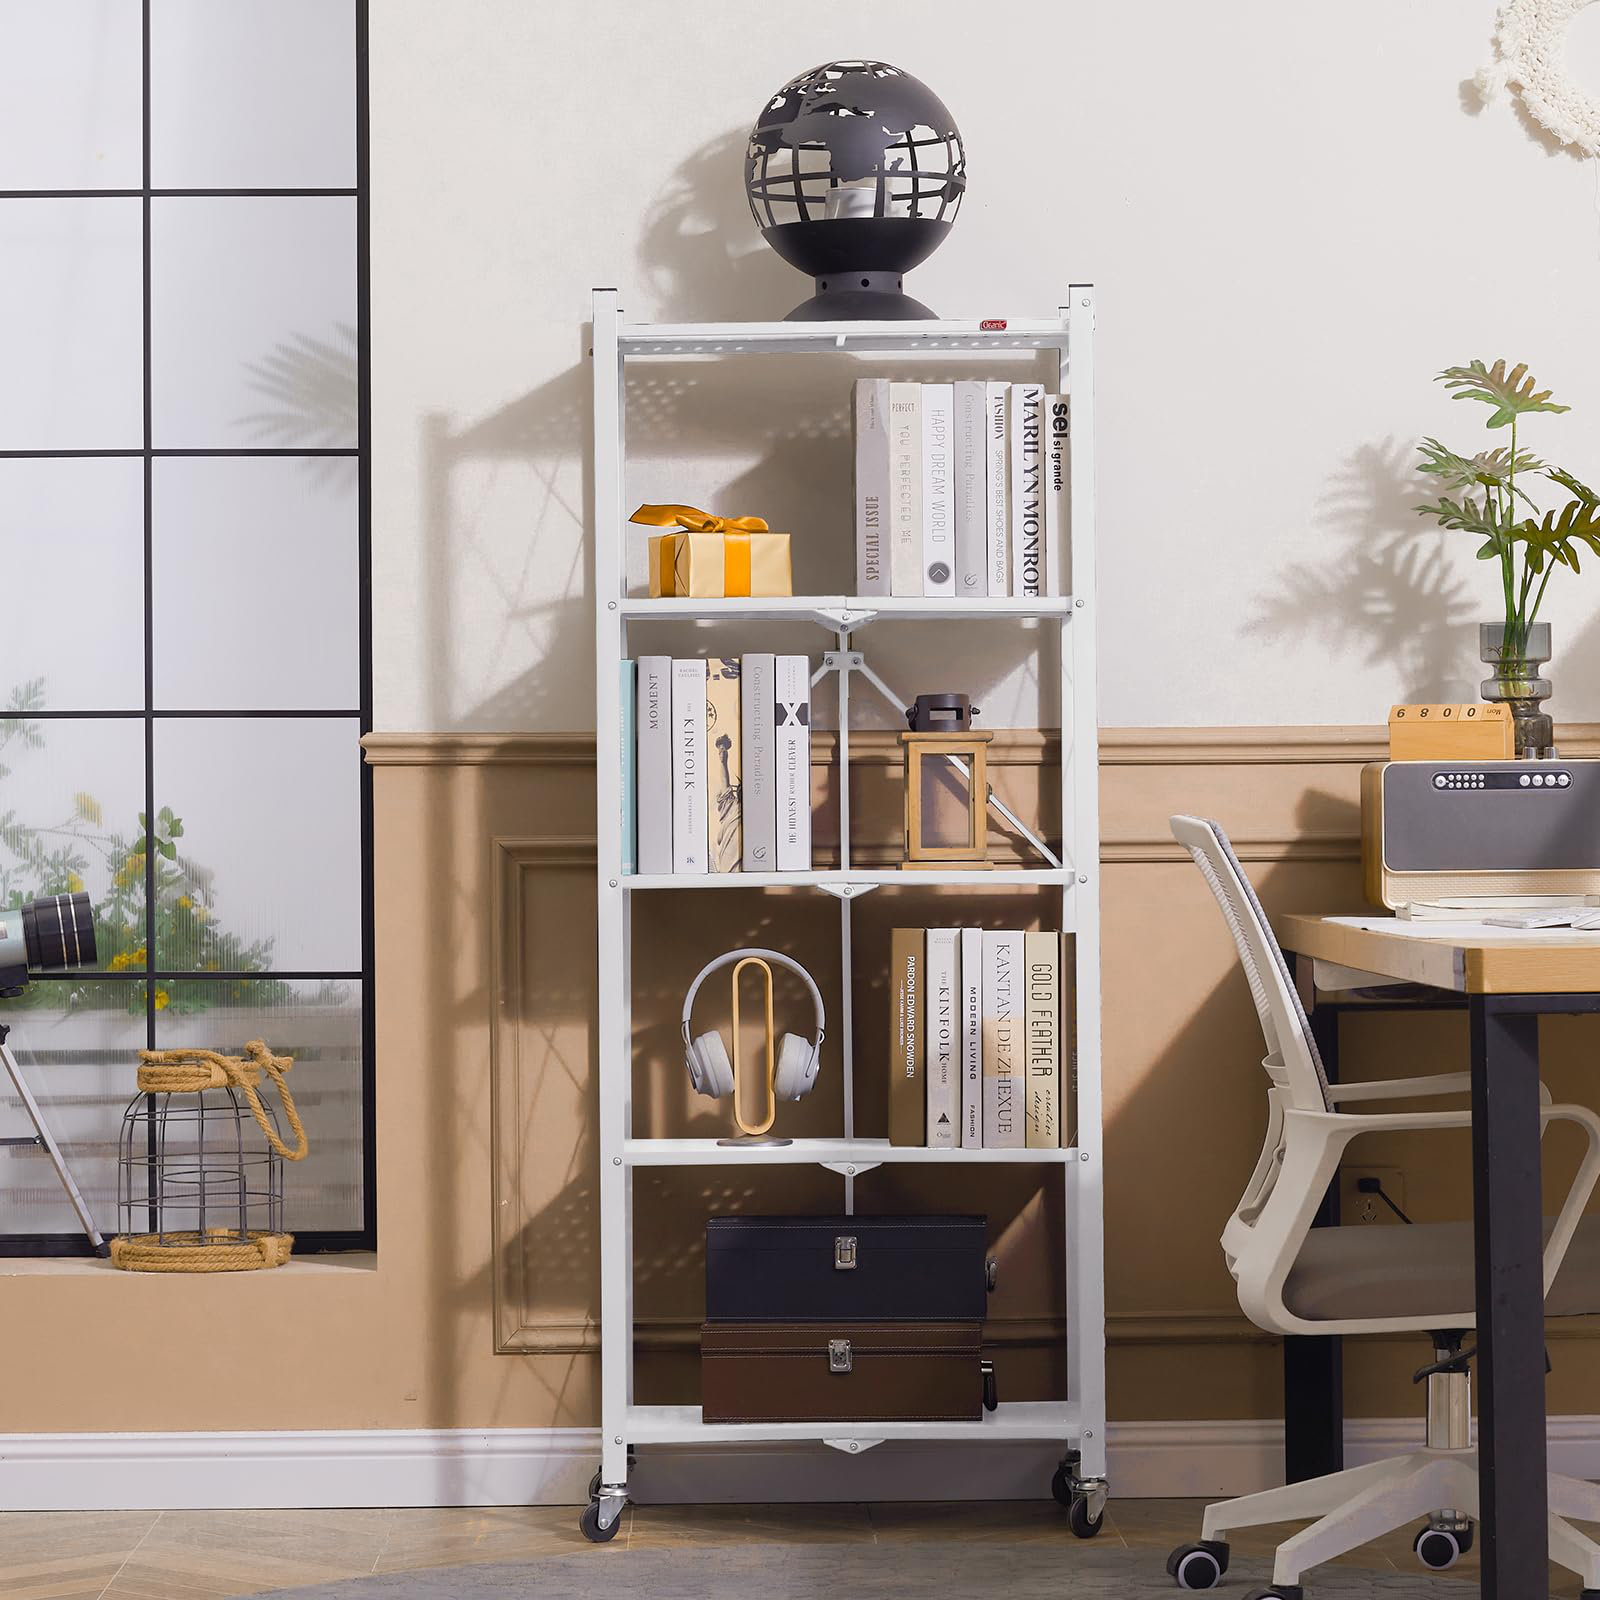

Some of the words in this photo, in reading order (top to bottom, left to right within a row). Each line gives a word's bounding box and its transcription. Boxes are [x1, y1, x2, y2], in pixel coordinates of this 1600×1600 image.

[892, 402, 915, 413] PERFECT
[994, 396, 1004, 440] FASHION
[899, 424, 911, 446] YOU
[931, 409, 946, 449] HAPPY
[964, 394, 975, 468] Constructing
[1023, 389, 1039, 493] MARILYN
[1053, 440, 1064, 450] si
[899, 454, 912, 522] PERFECTED
[931, 453, 946, 495] DREAM
[1051, 452, 1064, 491] grande
[865, 496, 879, 528] ISSUE
[995, 490, 1004, 507] BEST
[901, 530, 912, 544] ME
[931, 500, 946, 543] WORLD
[995, 510, 1004, 537] SHOES
[865, 533, 880, 581] SPECIAL
[995, 539, 1004, 558] AND
[1023, 500, 1039, 597] MONROE
[995, 560, 1005, 584] BAGS
[648, 673, 659, 730] MOMENT
[753, 666, 763, 741] Constructing
[683, 719, 696, 790] KINFOLK
[754, 746, 765, 795] Paradies
[788, 739, 797, 771] CLEVER
[788, 797, 797, 830] HONEST
[788, 832, 797, 844] BE
[906, 956, 916, 993] PARDON
[996, 944, 1011, 1023] KANTAN
[1031, 964, 1053, 1001] GOLD
[906, 994, 915, 1032] EDWARD
[939, 987, 950, 1062] KINFOLK
[969, 986, 977, 1036] MODERN
[906, 1033, 915, 1078] SNOWDEN
[969, 1041, 977, 1080] LIVING
[998, 1029, 1012, 1053] DE
[1031, 1010, 1053, 1077] FEATHER
[998, 1058, 1012, 1134] ZHEXUE
[1026, 1091, 1042, 1133] design
[1045, 1089, 1055, 1136] creative
